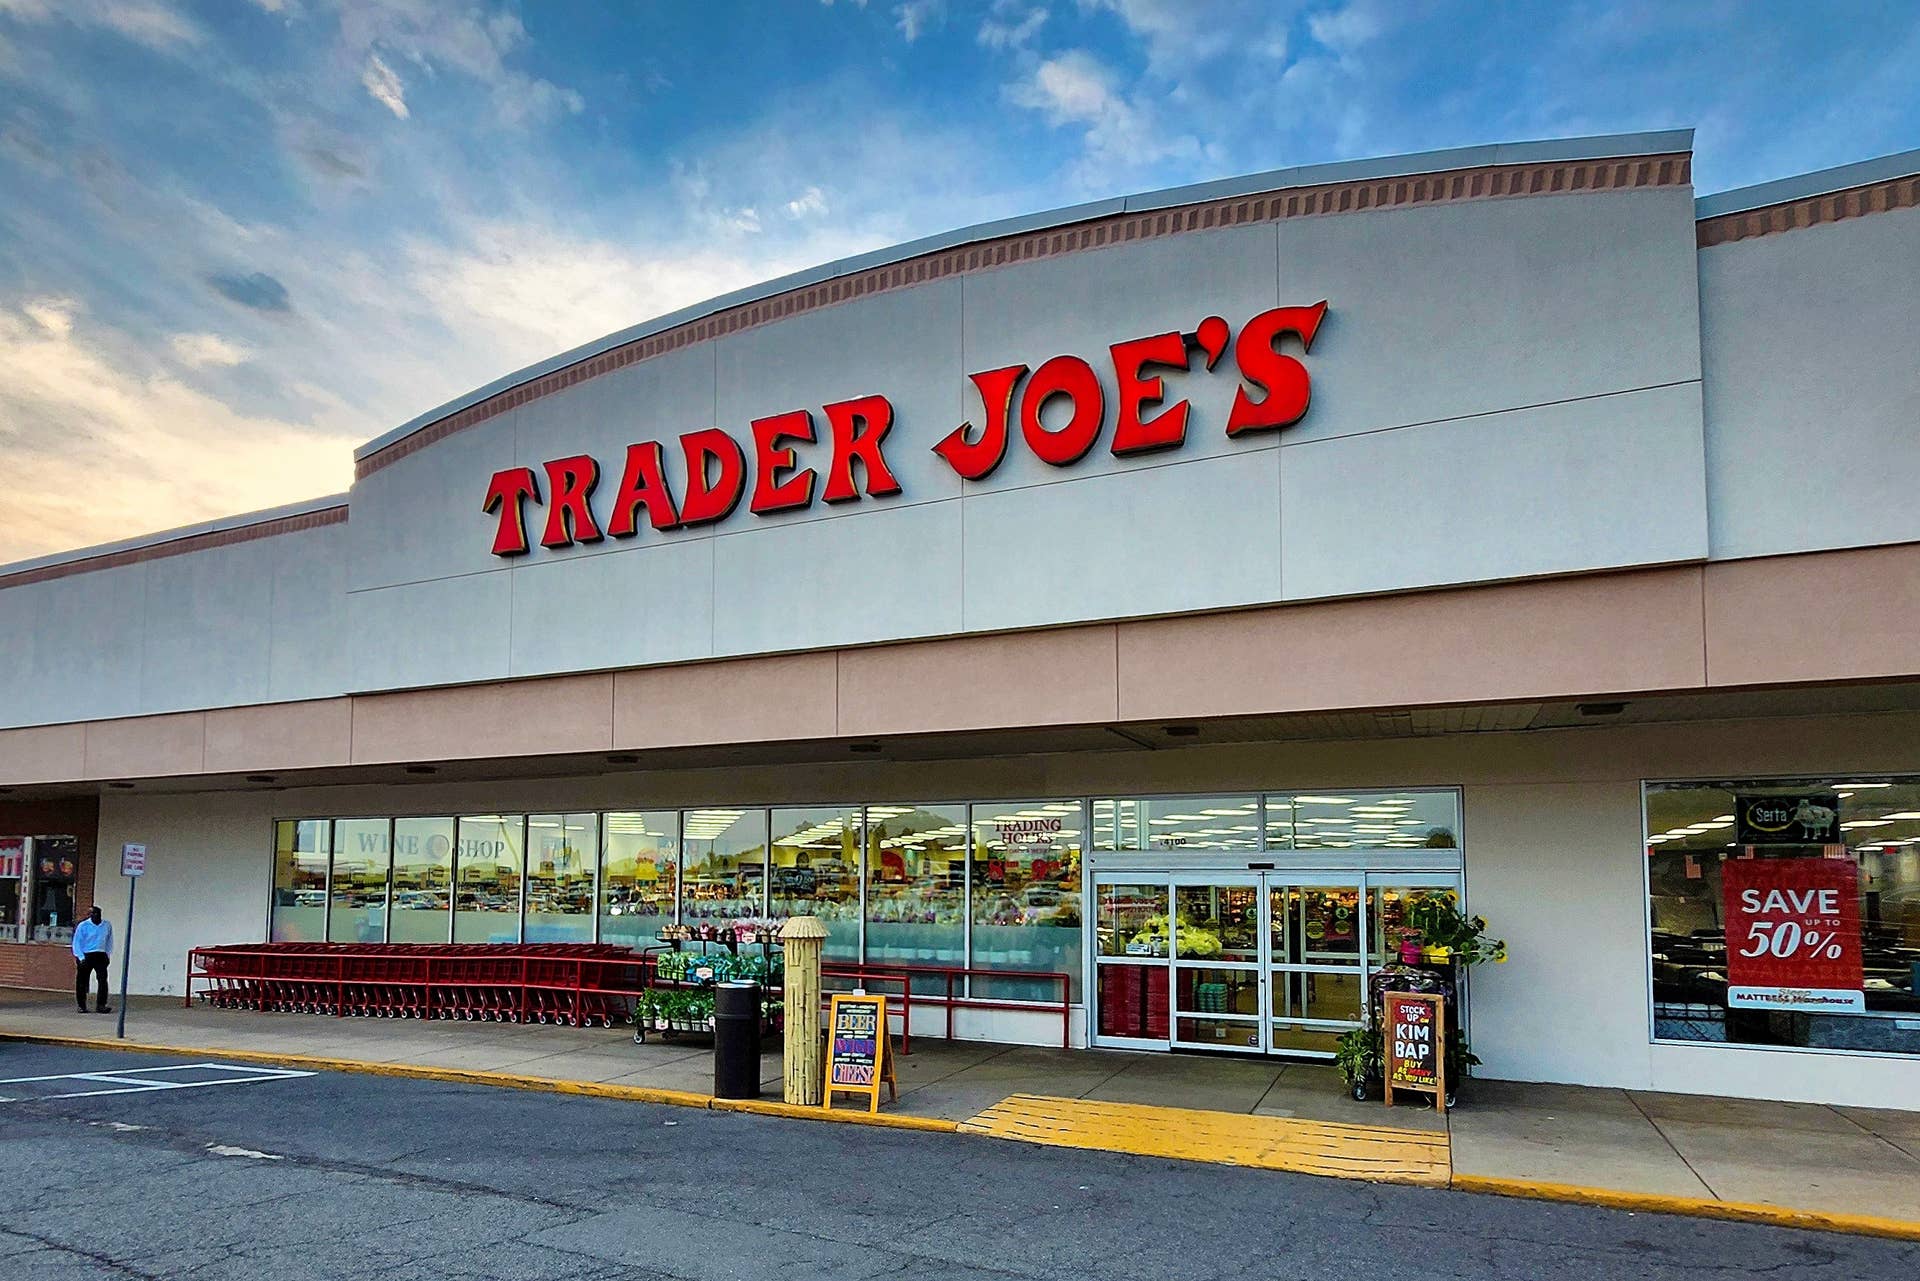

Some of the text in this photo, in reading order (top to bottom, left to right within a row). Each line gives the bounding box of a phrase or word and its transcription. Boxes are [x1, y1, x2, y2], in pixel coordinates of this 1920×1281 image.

[483, 299, 1329, 557] TRADER JOE'S
[1756, 807, 1787, 822] Serta
[994, 818, 1062, 832] TRADING
[357, 832, 505, 859] WINE SHOP
[1741, 889, 1840, 914] SAVE
[1739, 921, 1842, 959] 50%
[1400, 1005, 1425, 1015] STOCK
[1407, 1014, 1419, 1022] UP
[837, 1014, 876, 1031] BEER
[1396, 1023, 1429, 1041] KIM
[1395, 1041, 1429, 1060] BAP
[1398, 1066, 1407, 1075] AS
[1404, 1060, 1423, 1068] BUY
[833, 1063, 875, 1084] CHEESE
[1393, 1072, 1402, 1080] AS
